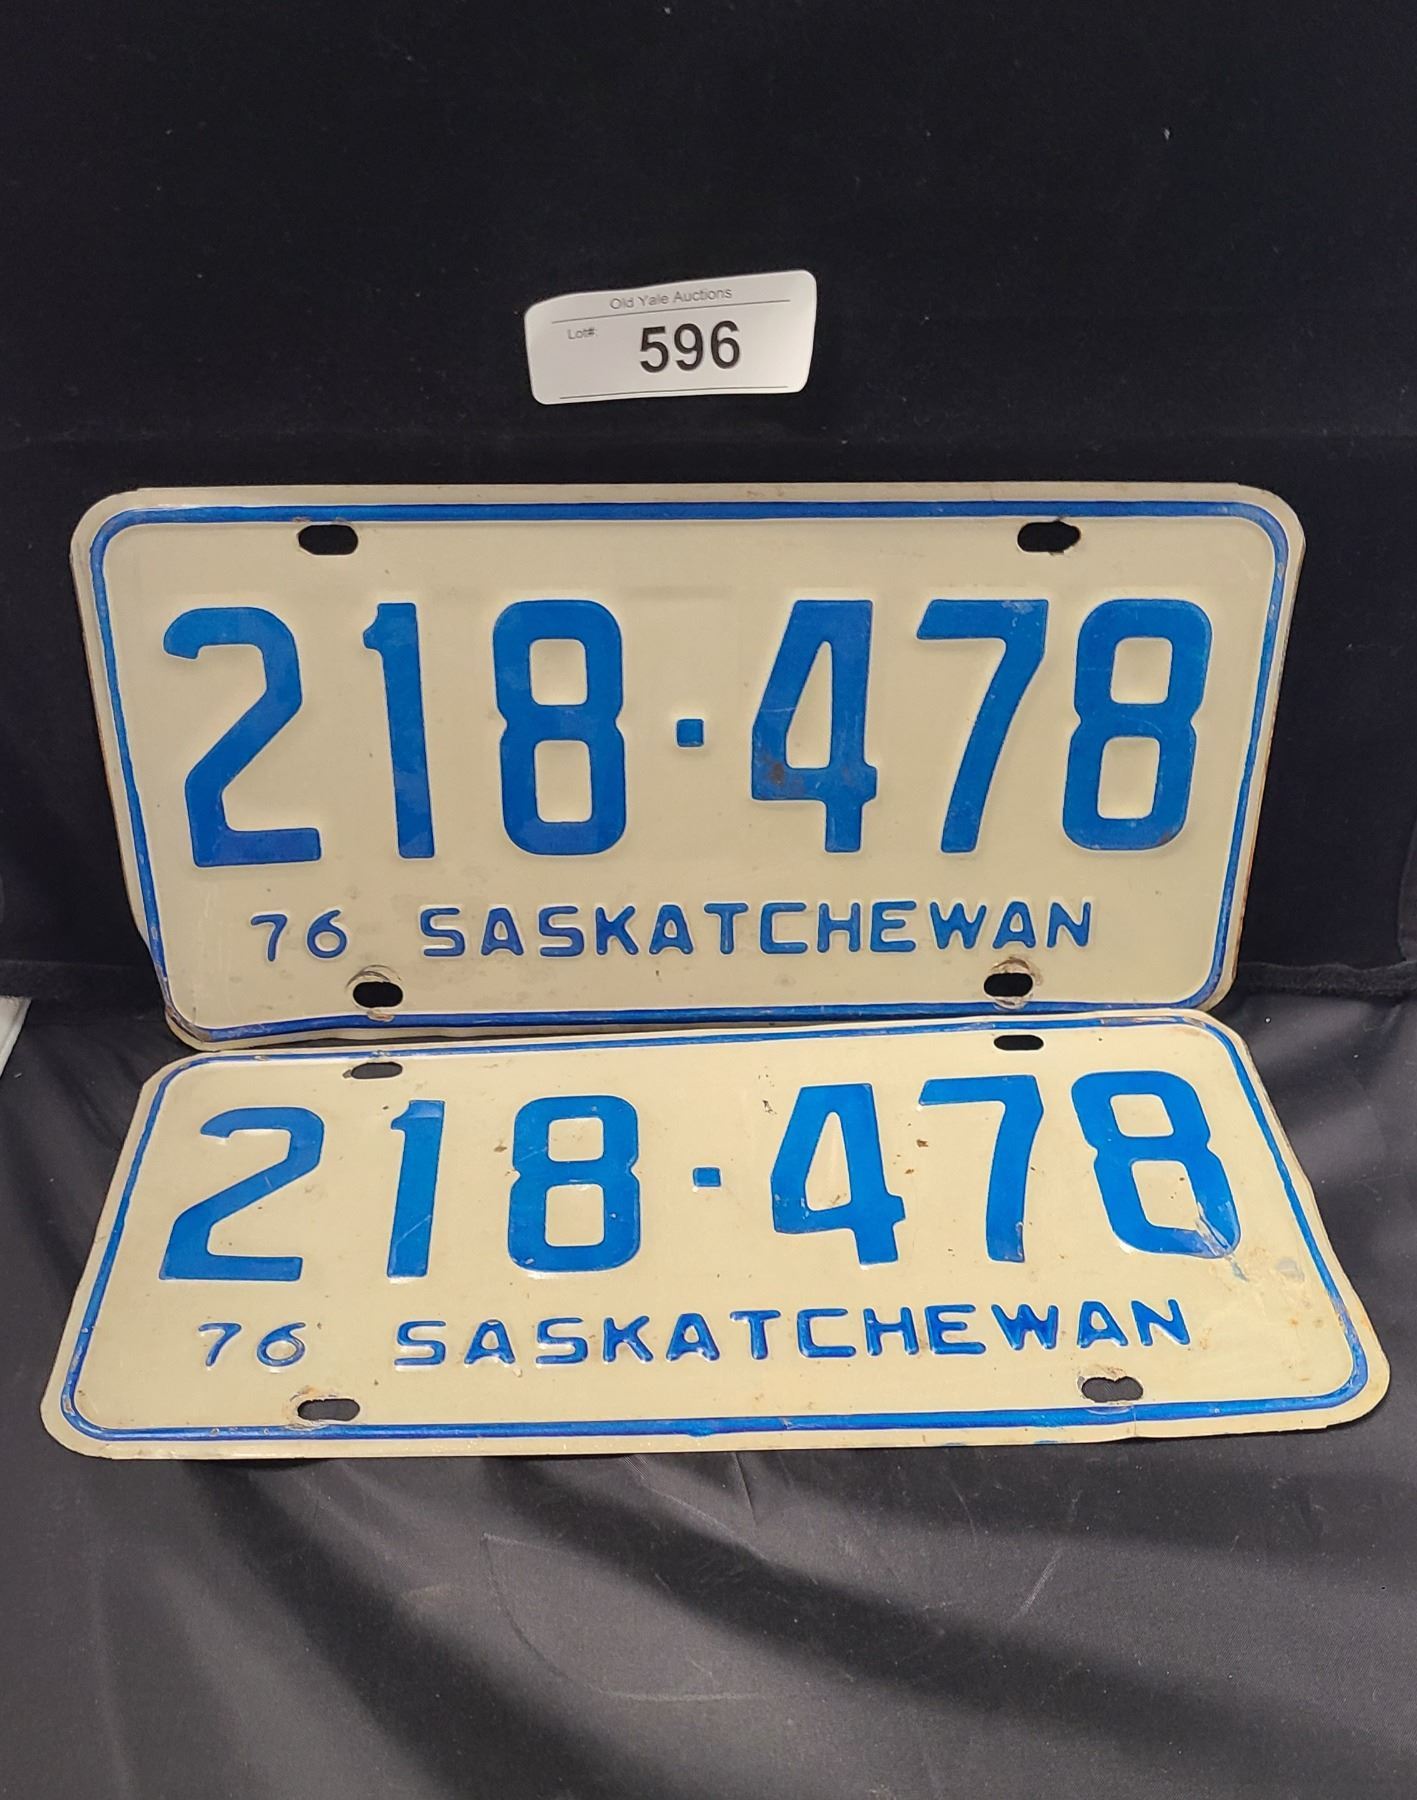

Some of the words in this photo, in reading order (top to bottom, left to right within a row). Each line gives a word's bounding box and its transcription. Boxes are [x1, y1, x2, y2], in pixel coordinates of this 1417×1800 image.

[609, 297, 635, 310] Old
[638, 294, 669, 306] Yale
[672, 287, 733, 303] Auctions
[640, 320, 740, 373] 596
[252, 910, 346, 960] 76
[420, 900, 1092, 957] SASKATCHEWAN
[201, 1322, 306, 1367] 76
[396, 1298, 1190, 1367] SASKATCHEWAN
